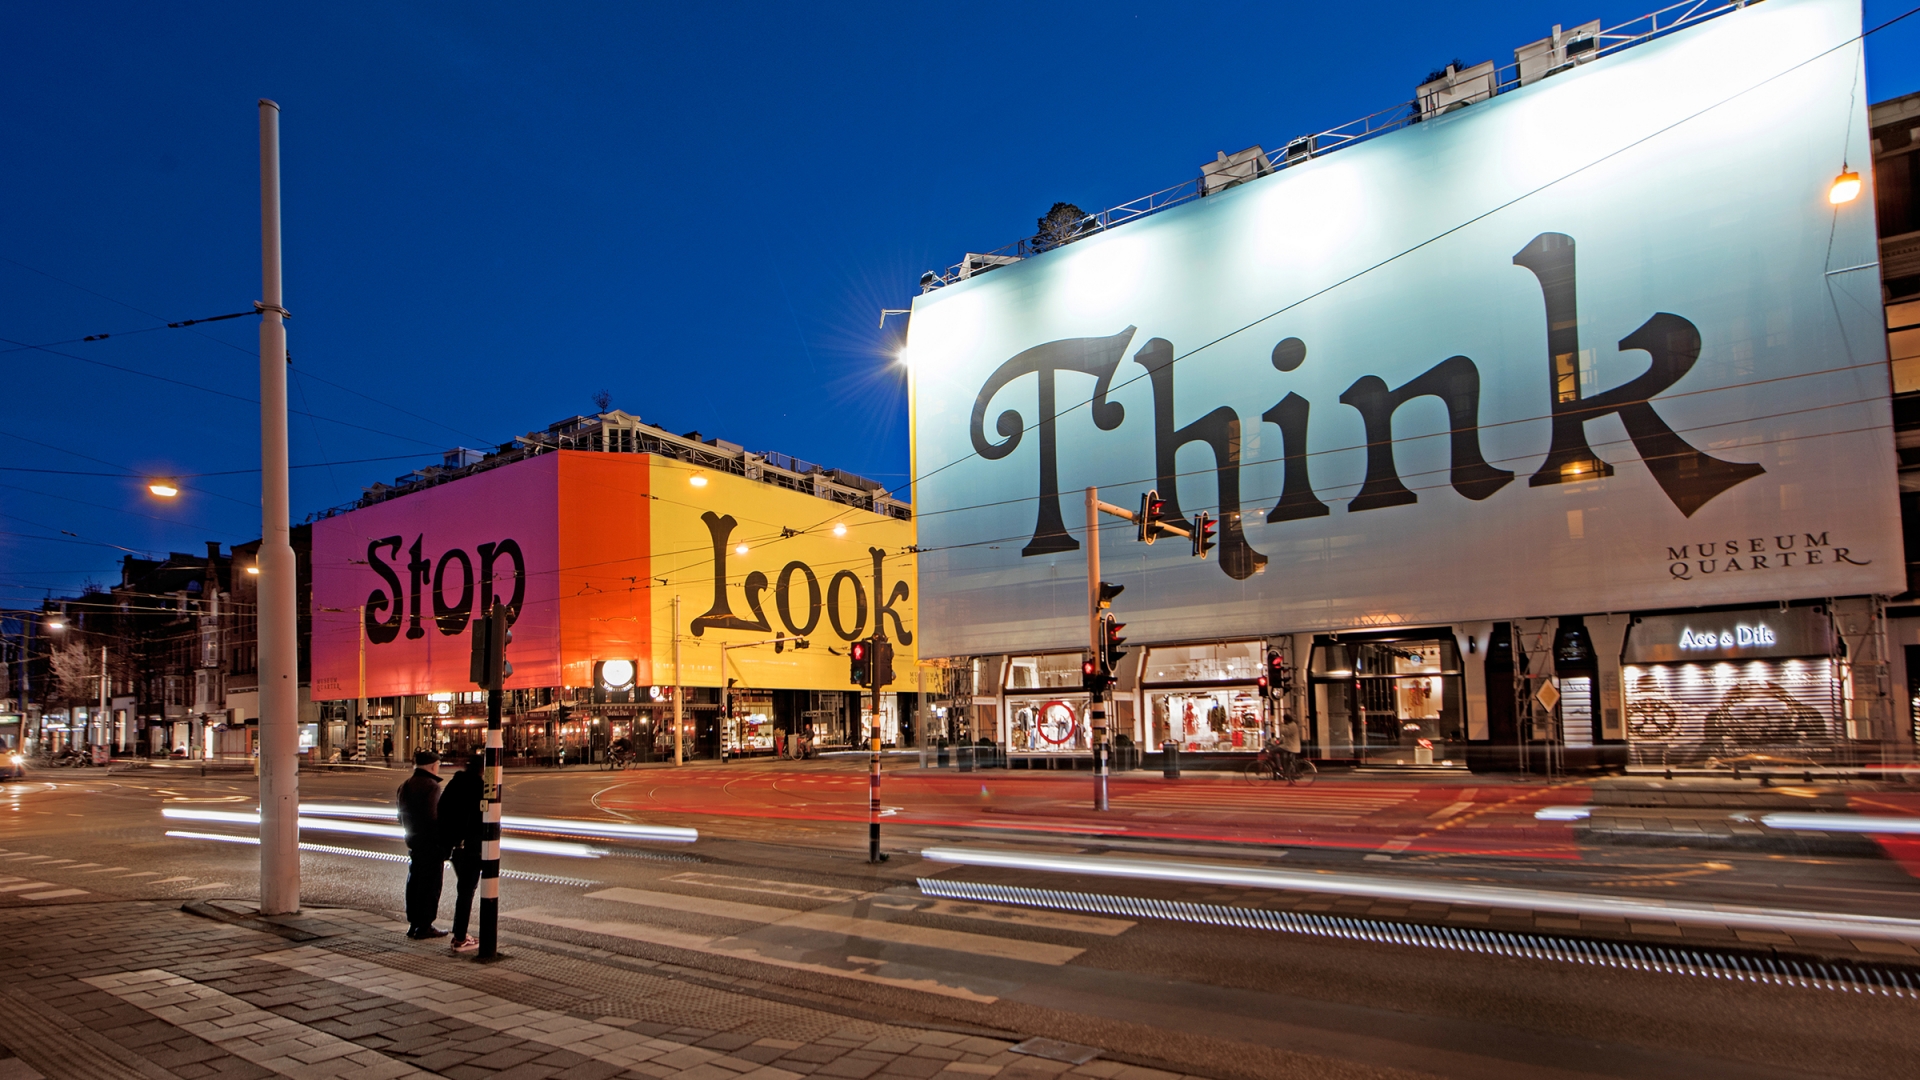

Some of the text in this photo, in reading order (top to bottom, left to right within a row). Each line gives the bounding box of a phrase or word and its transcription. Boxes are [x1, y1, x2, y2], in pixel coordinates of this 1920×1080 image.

[970, 231, 1766, 580] Think
[1667, 531, 1831, 561] MUSEUM
[1669, 547, 1873, 581] QUARTER
[365, 533, 526, 645] Stop
[690, 511, 913, 655] Look
[1720, 630, 1734, 648] &
[1735, 621, 1776, 648] Dik
